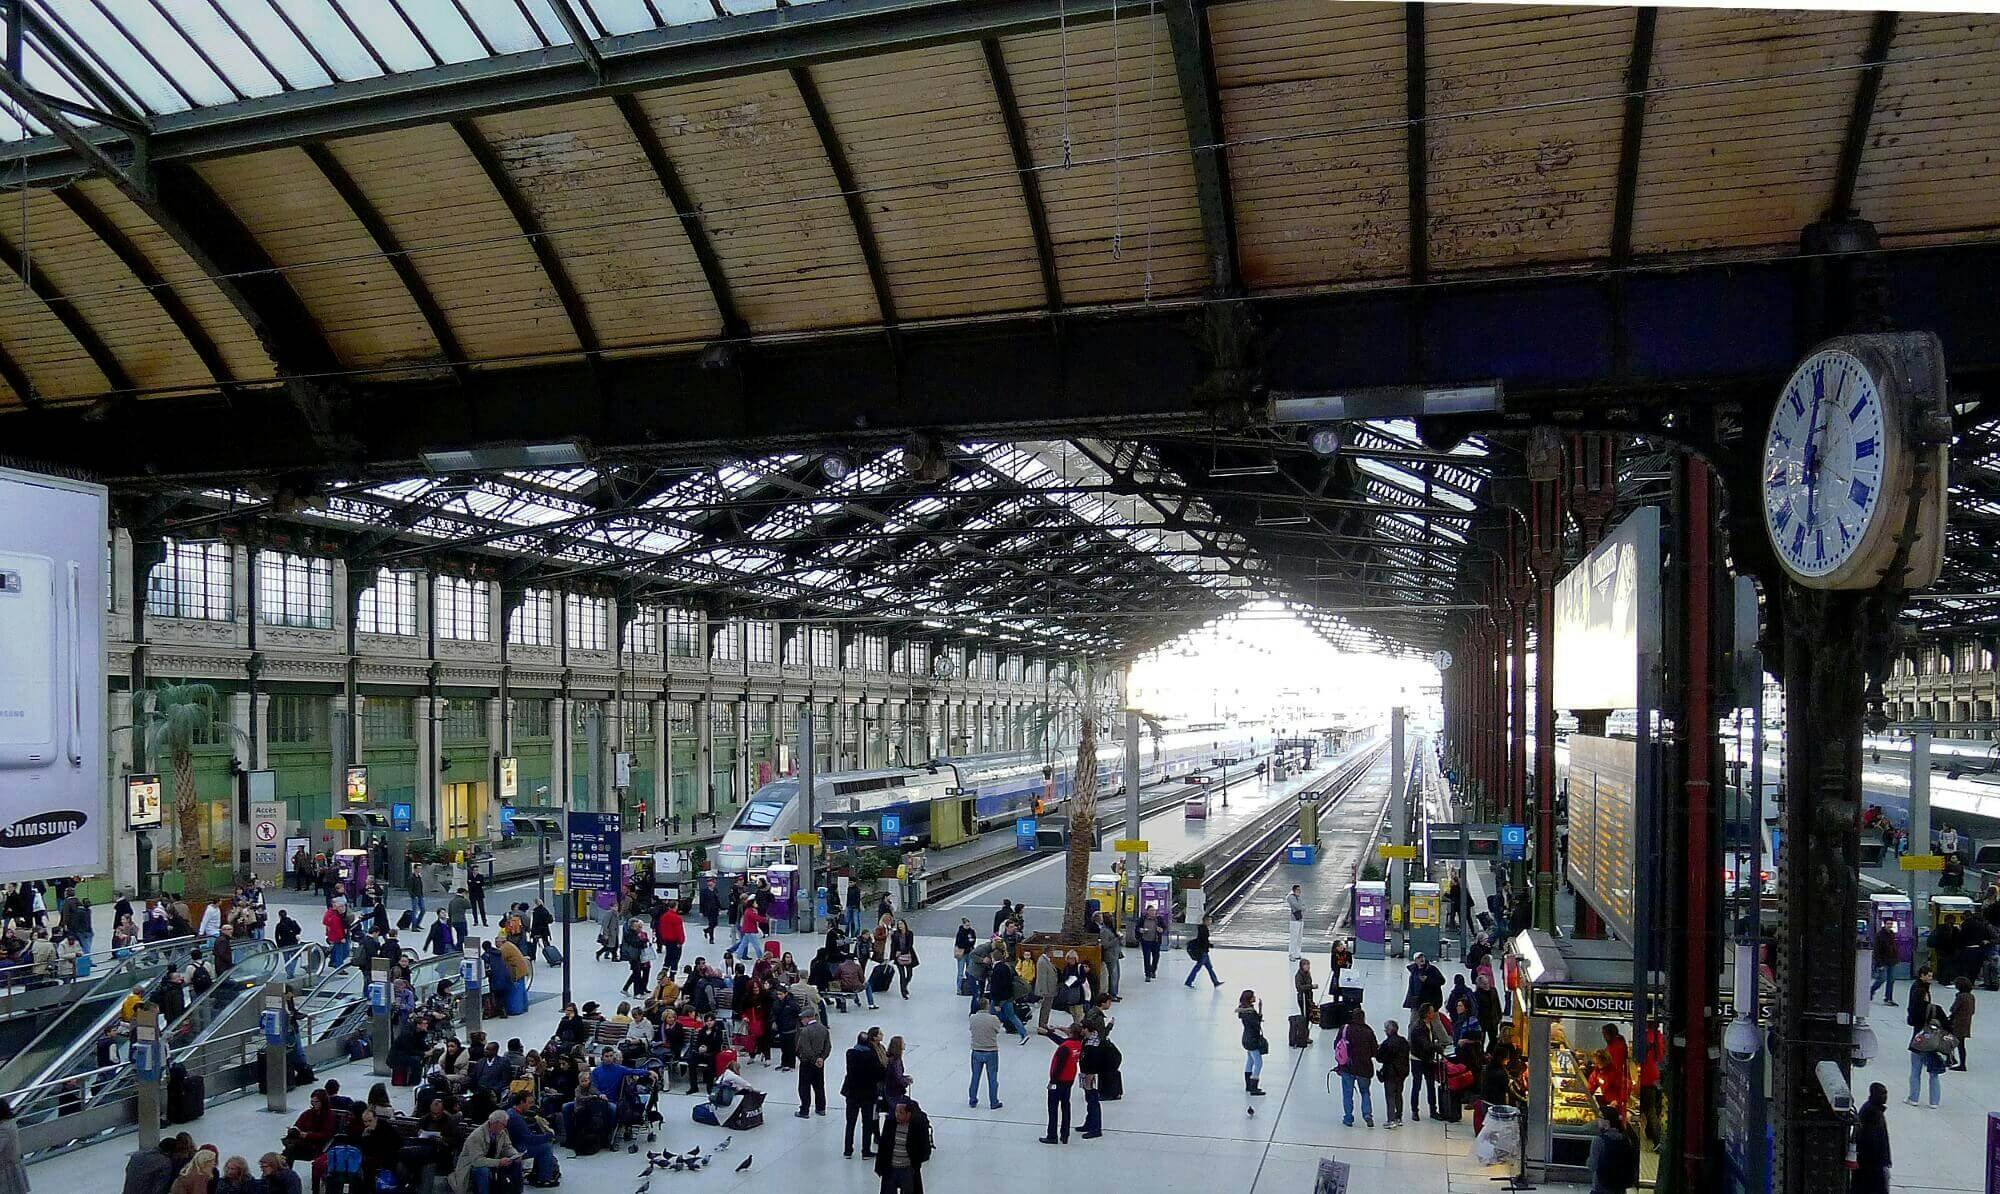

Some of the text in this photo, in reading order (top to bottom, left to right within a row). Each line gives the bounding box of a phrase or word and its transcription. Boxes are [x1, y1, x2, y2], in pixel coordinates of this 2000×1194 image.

[398, 808, 406, 817] A
[887, 820, 895, 829] D
[1022, 824, 1029, 833] E
[5, 821, 78, 838] SAMSUNG
[1508, 831, 1519, 842] G
